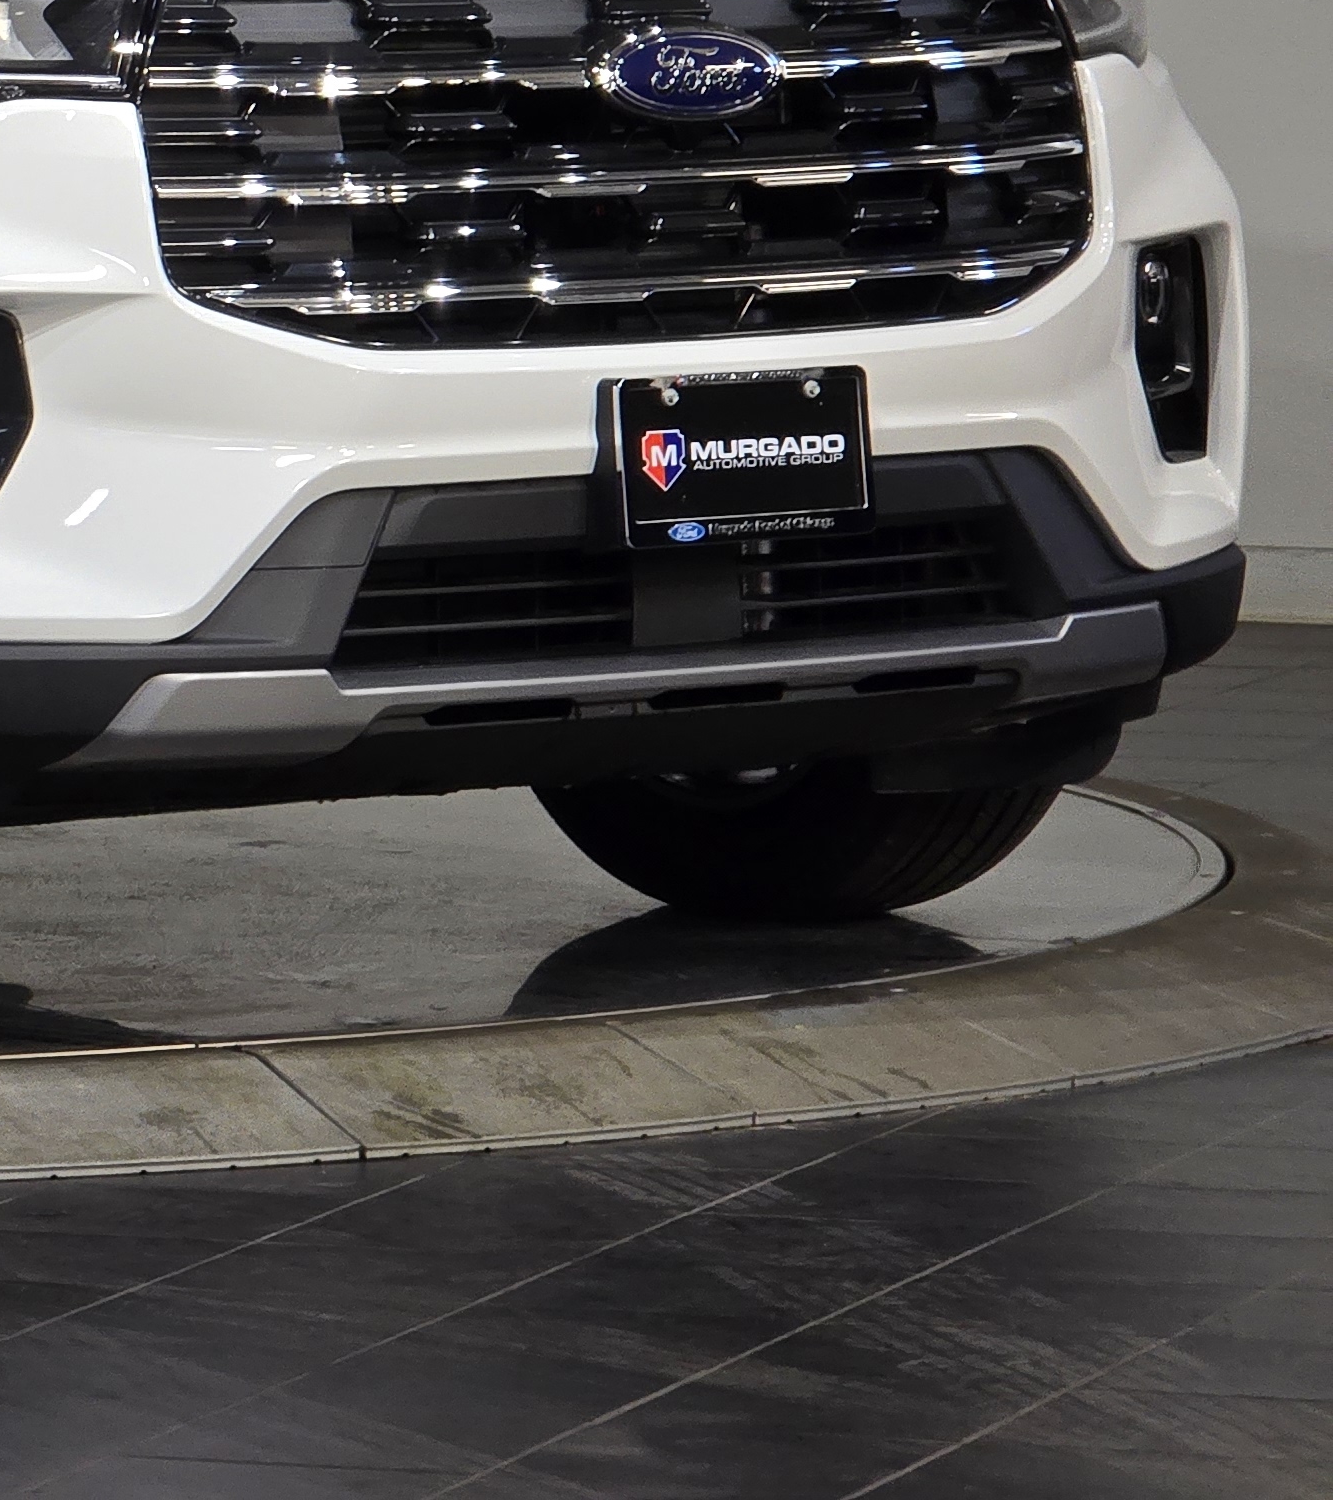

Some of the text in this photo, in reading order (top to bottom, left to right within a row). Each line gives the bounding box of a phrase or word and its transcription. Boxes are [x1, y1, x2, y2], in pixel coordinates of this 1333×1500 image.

[650, 445, 678, 467] M
[690, 434, 845, 461] MURGADO
[693, 453, 844, 471] AUTOMOTIVE GROUP
